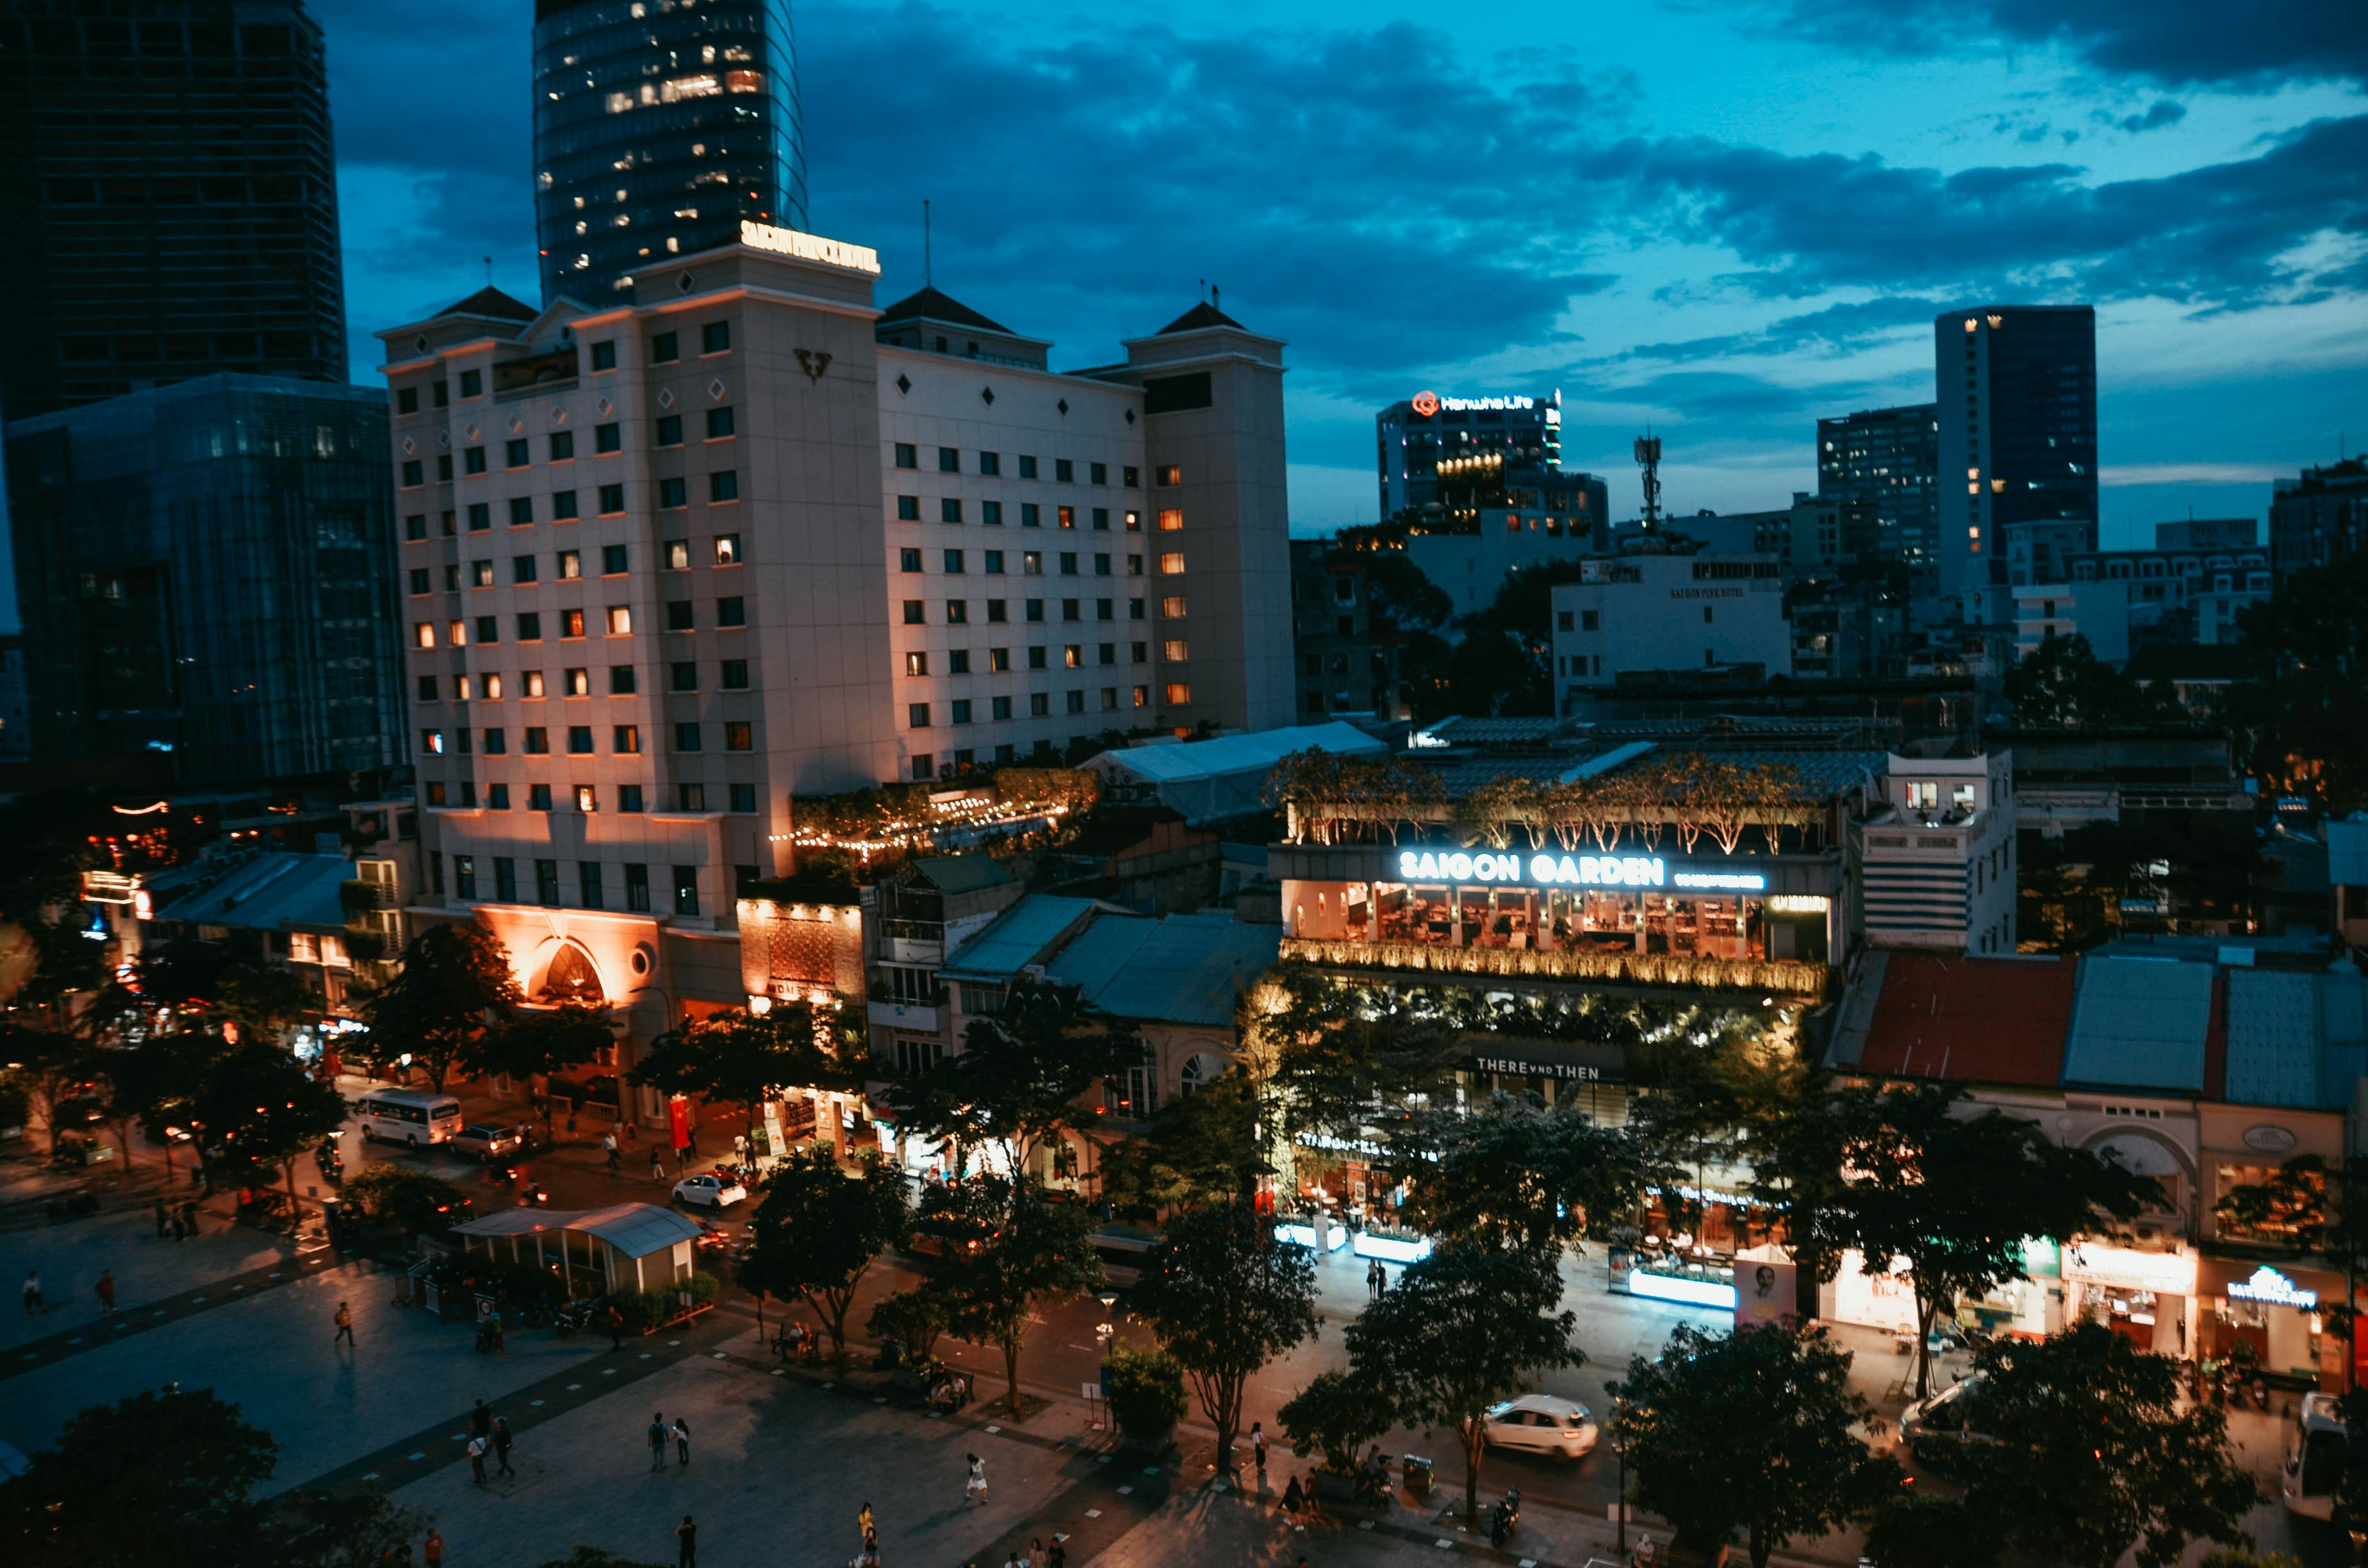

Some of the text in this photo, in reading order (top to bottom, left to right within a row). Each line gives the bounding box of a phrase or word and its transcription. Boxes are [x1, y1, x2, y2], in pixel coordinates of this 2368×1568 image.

[1399, 851, 1665, 886] SAIGON GARDEN
[1477, 1057, 1527, 1074] THERE
[1555, 1065, 1599, 1080] THEN
